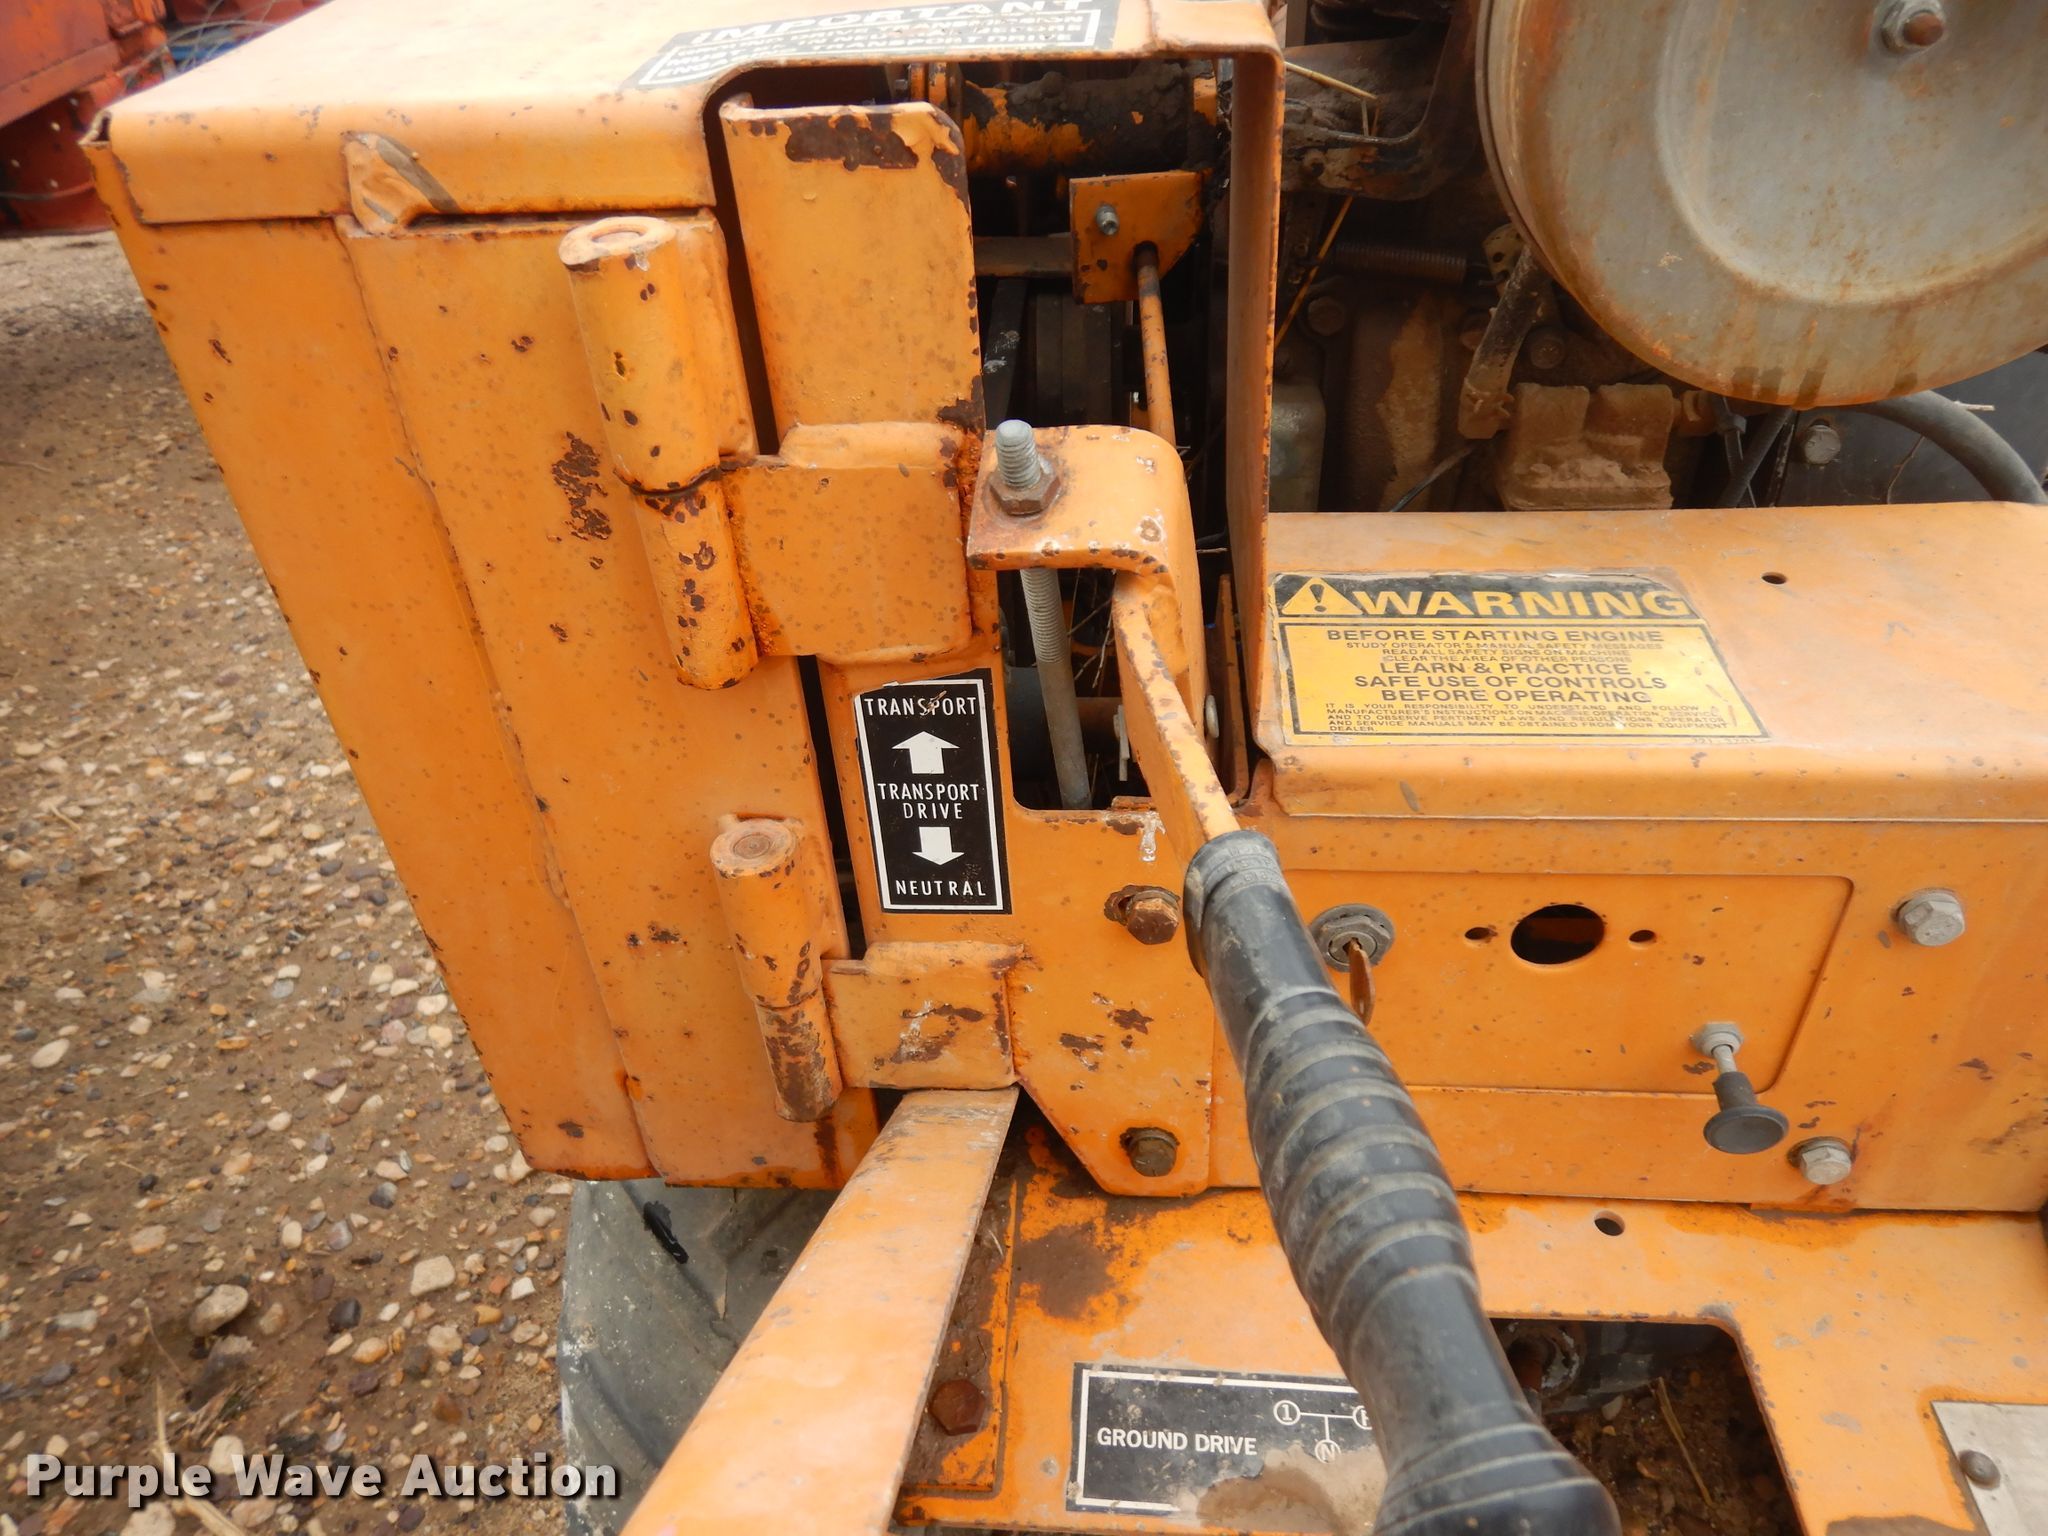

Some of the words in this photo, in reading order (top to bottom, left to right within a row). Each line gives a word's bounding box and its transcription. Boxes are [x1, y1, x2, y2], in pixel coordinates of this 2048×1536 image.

[691, 0, 1093, 45] IMPORTANT
[812, 35, 983, 51] TRANSPORT
[1352, 590, 1691, 616] WARNING
[1327, 629, 1426, 641] BEFORE
[1432, 630, 1558, 641] STARTING
[1566, 630, 1664, 642] ENGINE
[1379, 662, 1466, 674] LEARN
[1473, 662, 1492, 674] &
[1499, 662, 1632, 675] PRACTICE
[1354, 675, 1421, 687] SAFE
[1427, 675, 1480, 687] USE
[1484, 675, 1518, 687] OF
[1526, 676, 1667, 689] CONTROLS
[1381, 689, 1488, 702] BEFORE
[1494, 690, 1652, 703] OPERATING
[863, 696, 977, 716] TRANSPORT
[877, 782, 980, 801] TRANSPORT
[903, 802, 964, 820] DRIVE
[895, 879, 986, 896] NEUTRAL
[1281, 1403, 1293, 1422] 1
[1097, 1427, 1188, 1451] GROUND
[1195, 1433, 1258, 1456] DRIVE
